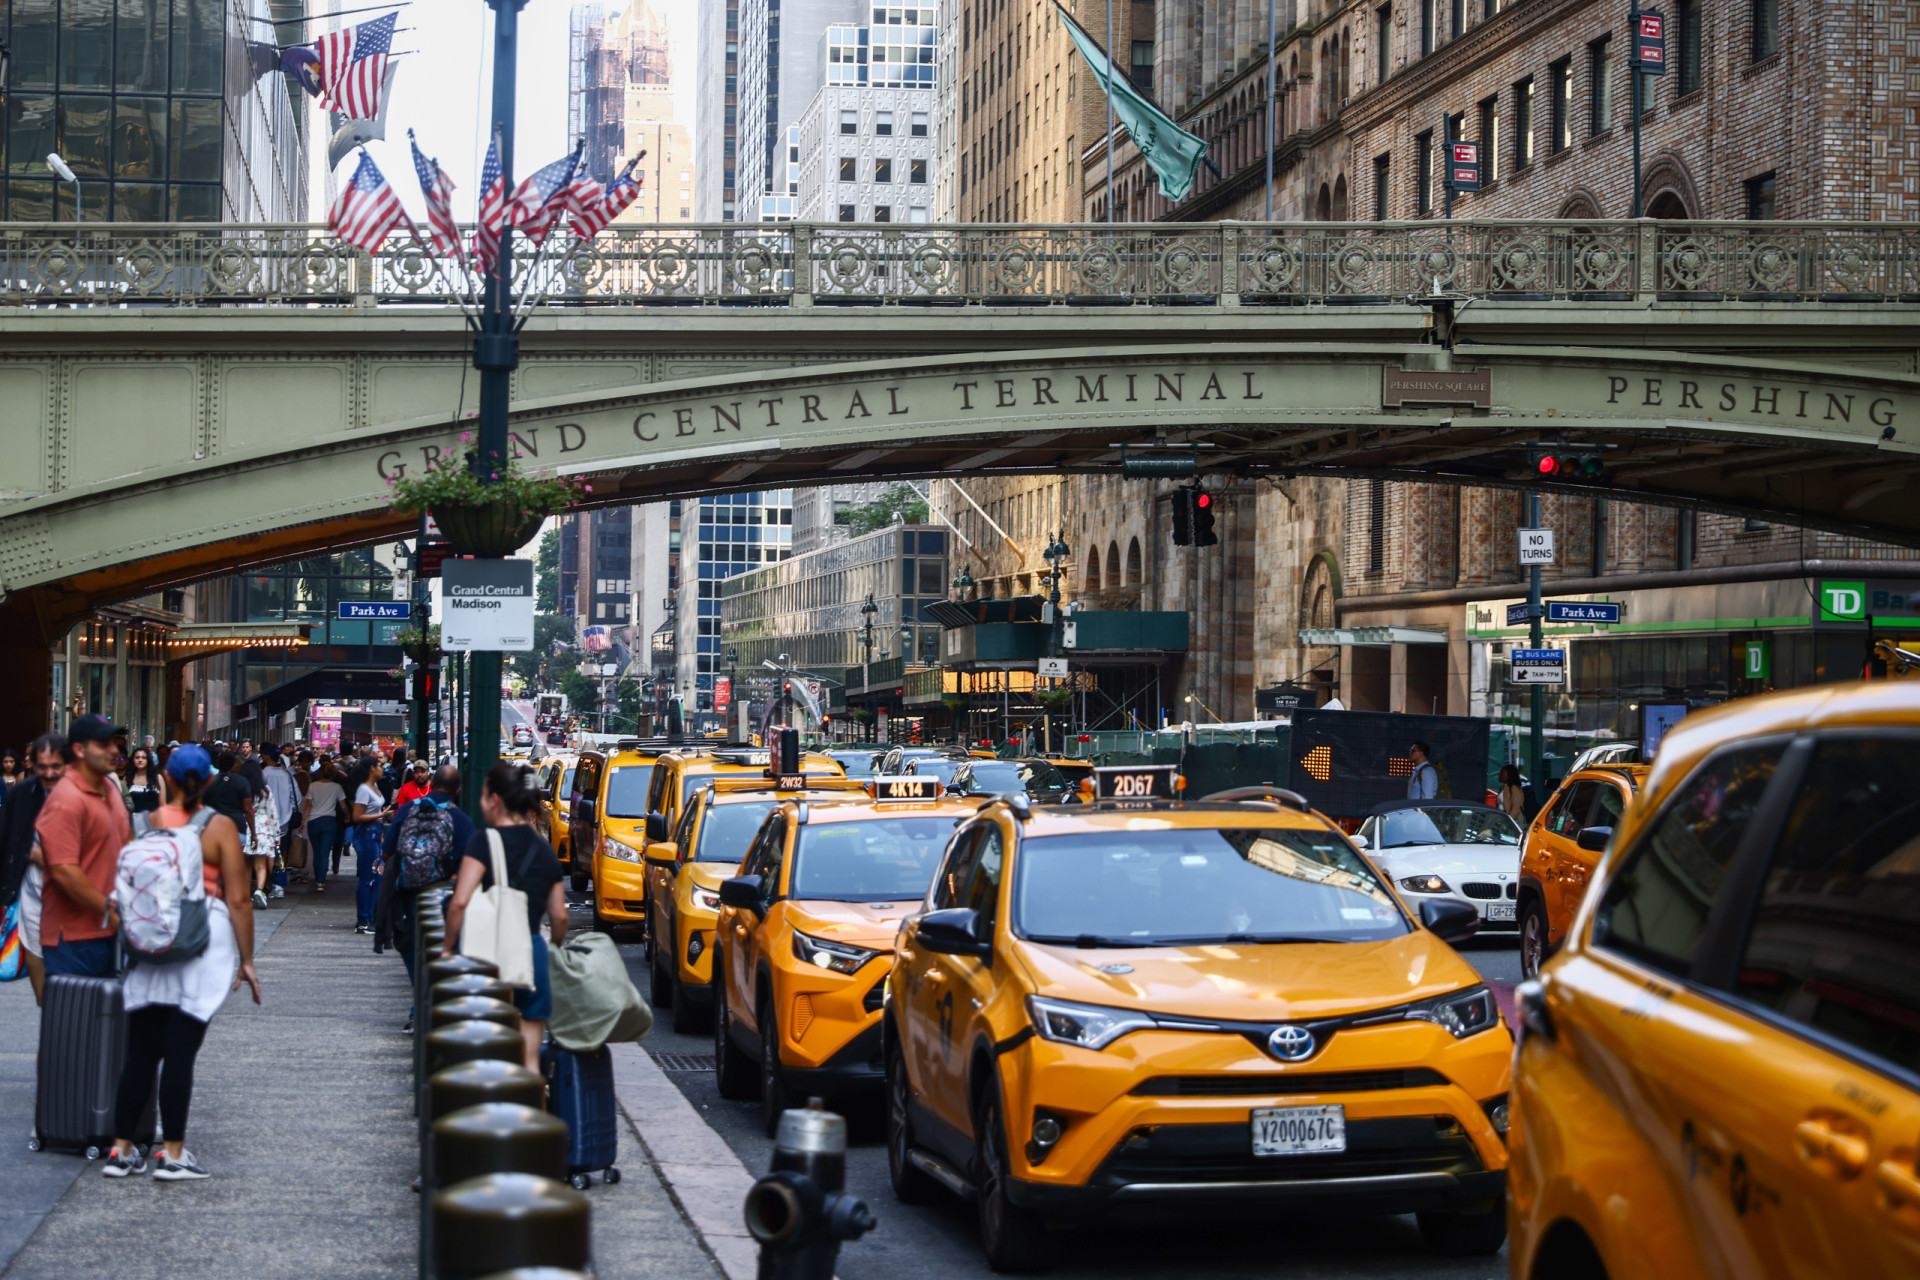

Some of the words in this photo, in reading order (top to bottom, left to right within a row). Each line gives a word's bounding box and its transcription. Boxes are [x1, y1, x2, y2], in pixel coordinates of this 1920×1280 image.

[1390, 381, 1442, 390] PERSHING
[1446, 382, 1486, 392] SQUARE
[1606, 376, 1897, 426] PERSHING
[376, 423, 586, 481] GRND
[632, 387, 910, 442] CENTRAL
[952, 372, 1264, 410] TERMINAL
[1529, 535, 1544, 546] NO
[1522, 549, 1552, 559] TURNS
[452, 585, 484, 595] Grand
[485, 585, 524, 595] Central
[452, 599, 501, 608] Madison
[1826, 589, 1861, 614] TD
[351, 606, 375, 616] Park
[378, 607, 398, 616] Ave
[1561, 607, 1585, 618] Park
[1587, 609, 1606, 618] Ave
[1749, 648, 1762, 672] TD
[780, 776, 803, 788] 2W32
[1114, 774, 1154, 796] 2D67
[888, 782, 923, 797] 4K14
[1261, 1118, 1334, 1143] Y200067C
